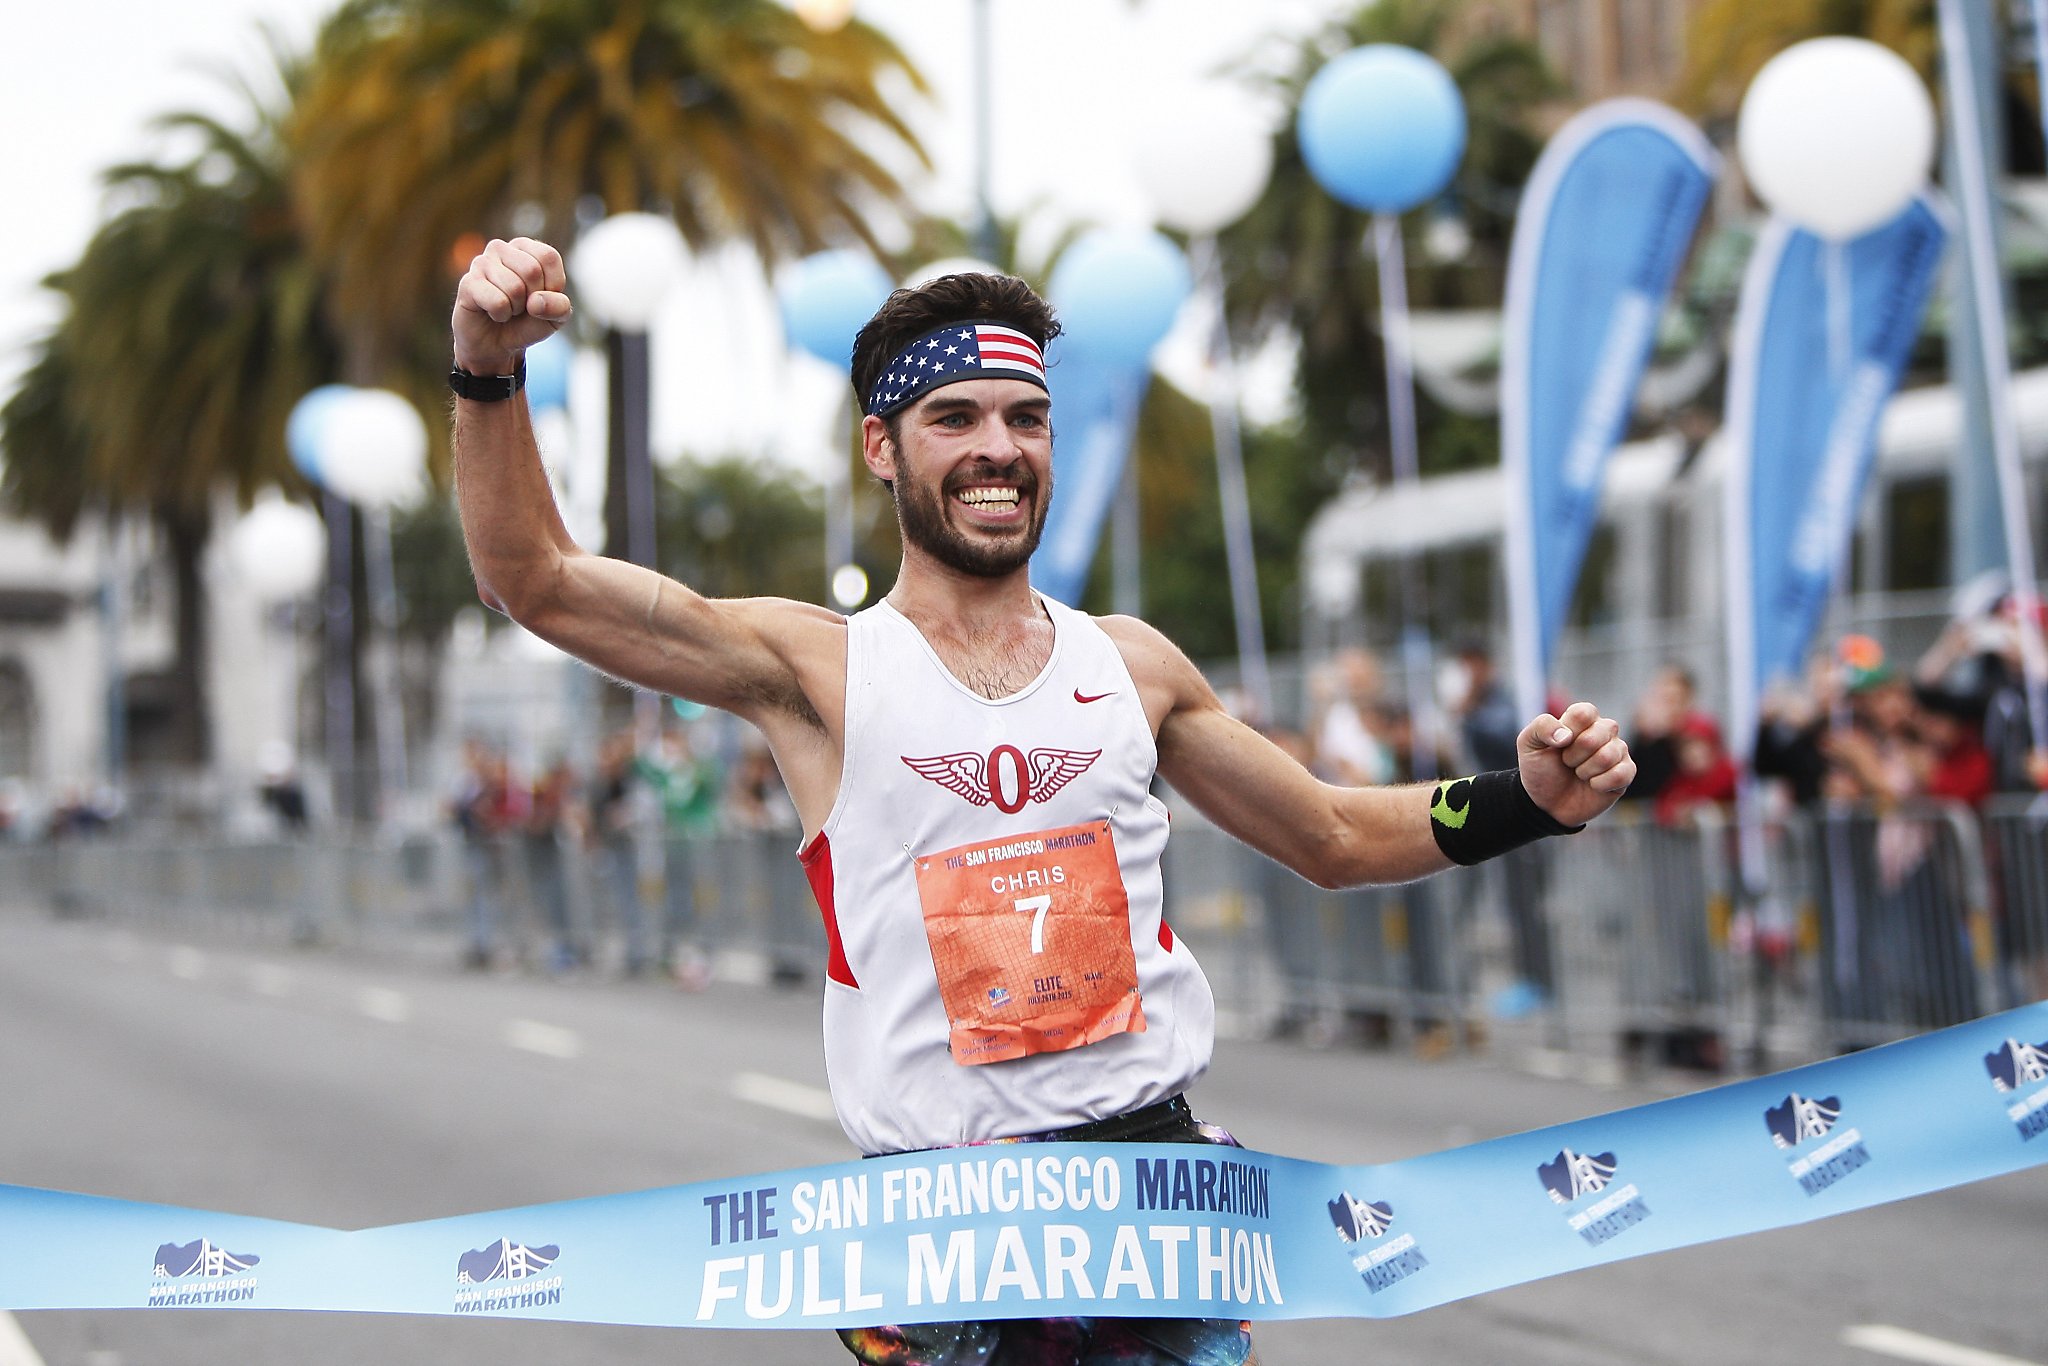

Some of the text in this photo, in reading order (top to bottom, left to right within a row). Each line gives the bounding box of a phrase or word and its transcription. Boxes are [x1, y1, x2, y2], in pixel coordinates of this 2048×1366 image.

[945, 832, 1096, 870] THE SAN FRANCISCO MARATHON
[991, 865, 1066, 894] CHRIS
[1014, 894, 1052, 955] 7
[1034, 976, 1063, 993] ELITE
[1084, 972, 1104, 982] WAVE
[1057, 990, 1073, 1000] 2015
[704, 1156, 1270, 1246] THE SAN FRANCISCO MARATHON
[1579, 1197, 1652, 1248] MARATHON
[695, 1224, 1284, 1321] FULL MARATHON
[1361, 1246, 1430, 1295] MARATHON
[148, 1287, 255, 1306] MARATHON
[150, 1279, 257, 1297] SAN FRANCISCO
[454, 1276, 562, 1303] SAN FRANCISCO
[454, 1288, 561, 1313] MARATHON
